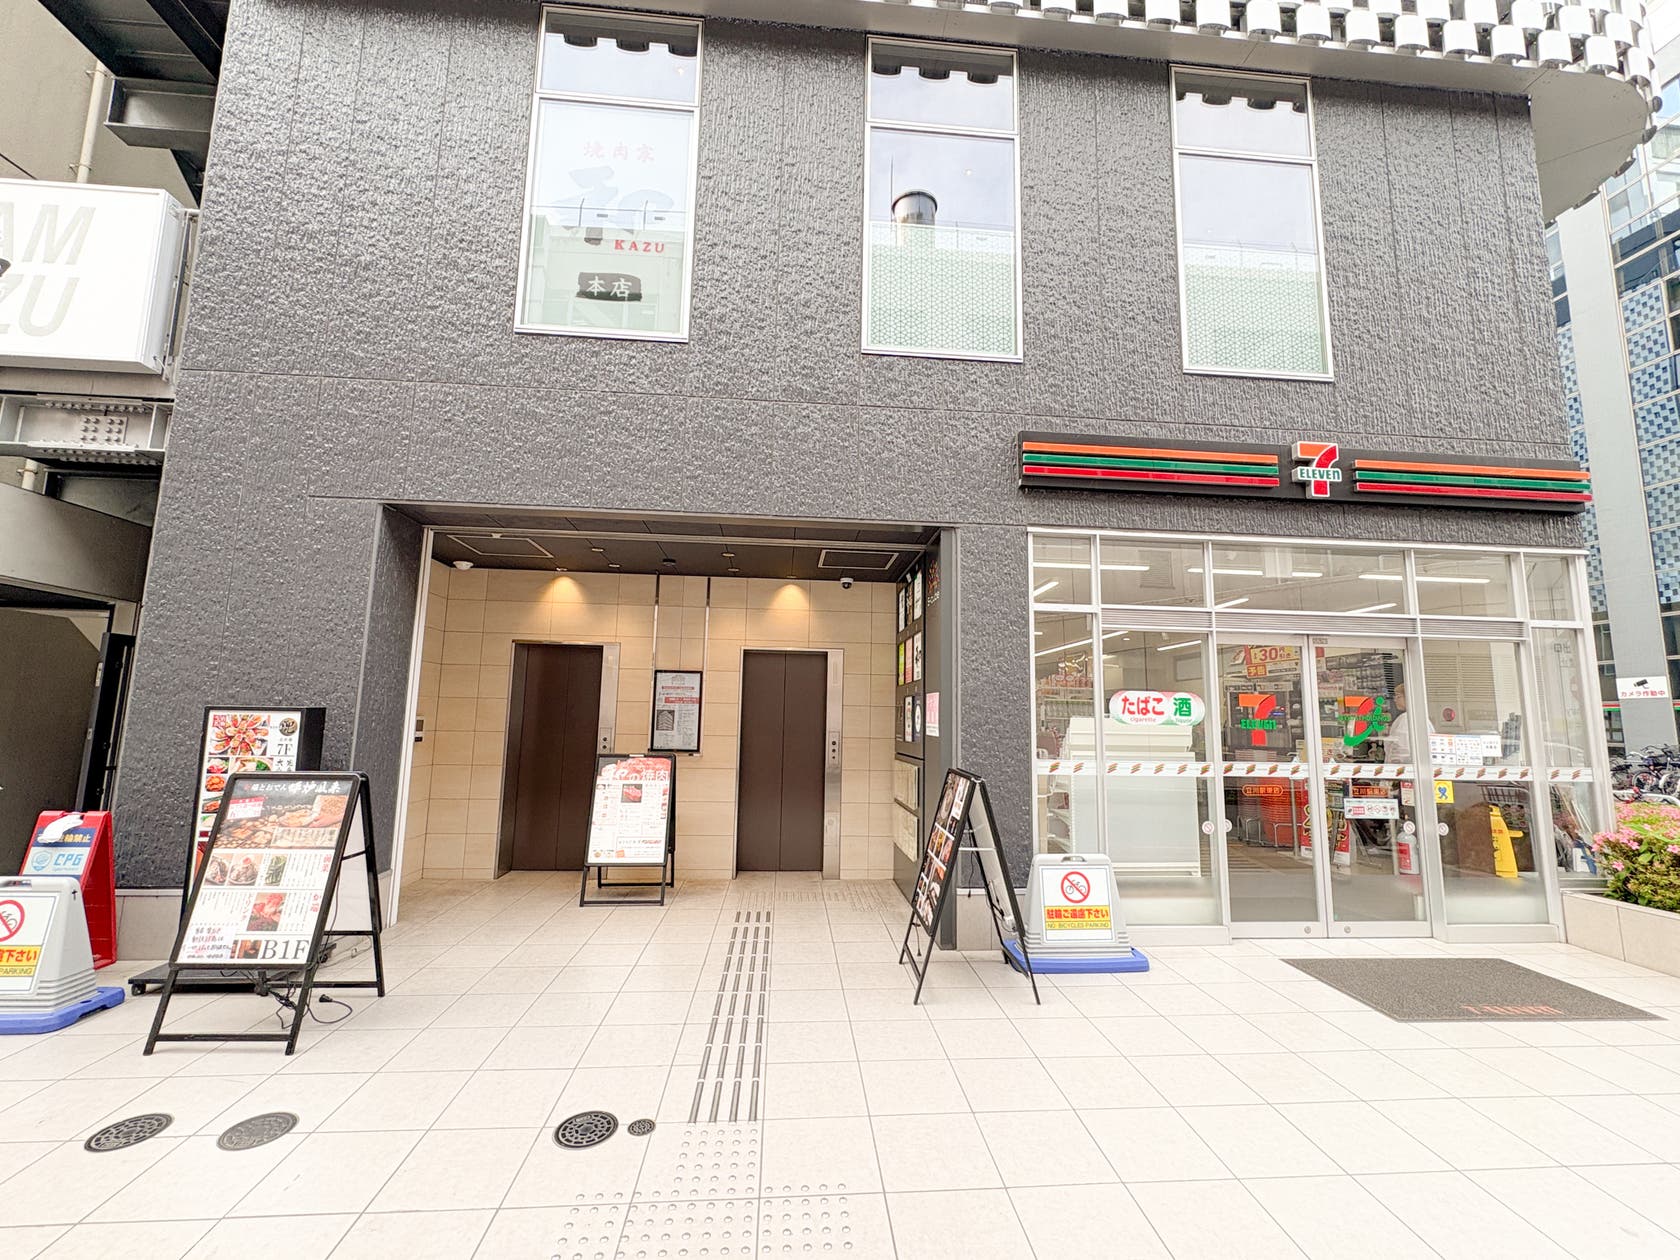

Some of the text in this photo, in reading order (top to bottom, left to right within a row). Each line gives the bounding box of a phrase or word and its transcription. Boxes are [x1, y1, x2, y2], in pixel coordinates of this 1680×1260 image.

[614, 239, 665, 253] KAZU
[587, 276, 633, 298] 本店
[1121, 695, 1192, 717] たばこ 酒
[278, 743, 294, 755] 7F
[53, 853, 85, 866] CPG
[261, 939, 310, 960] B1F
